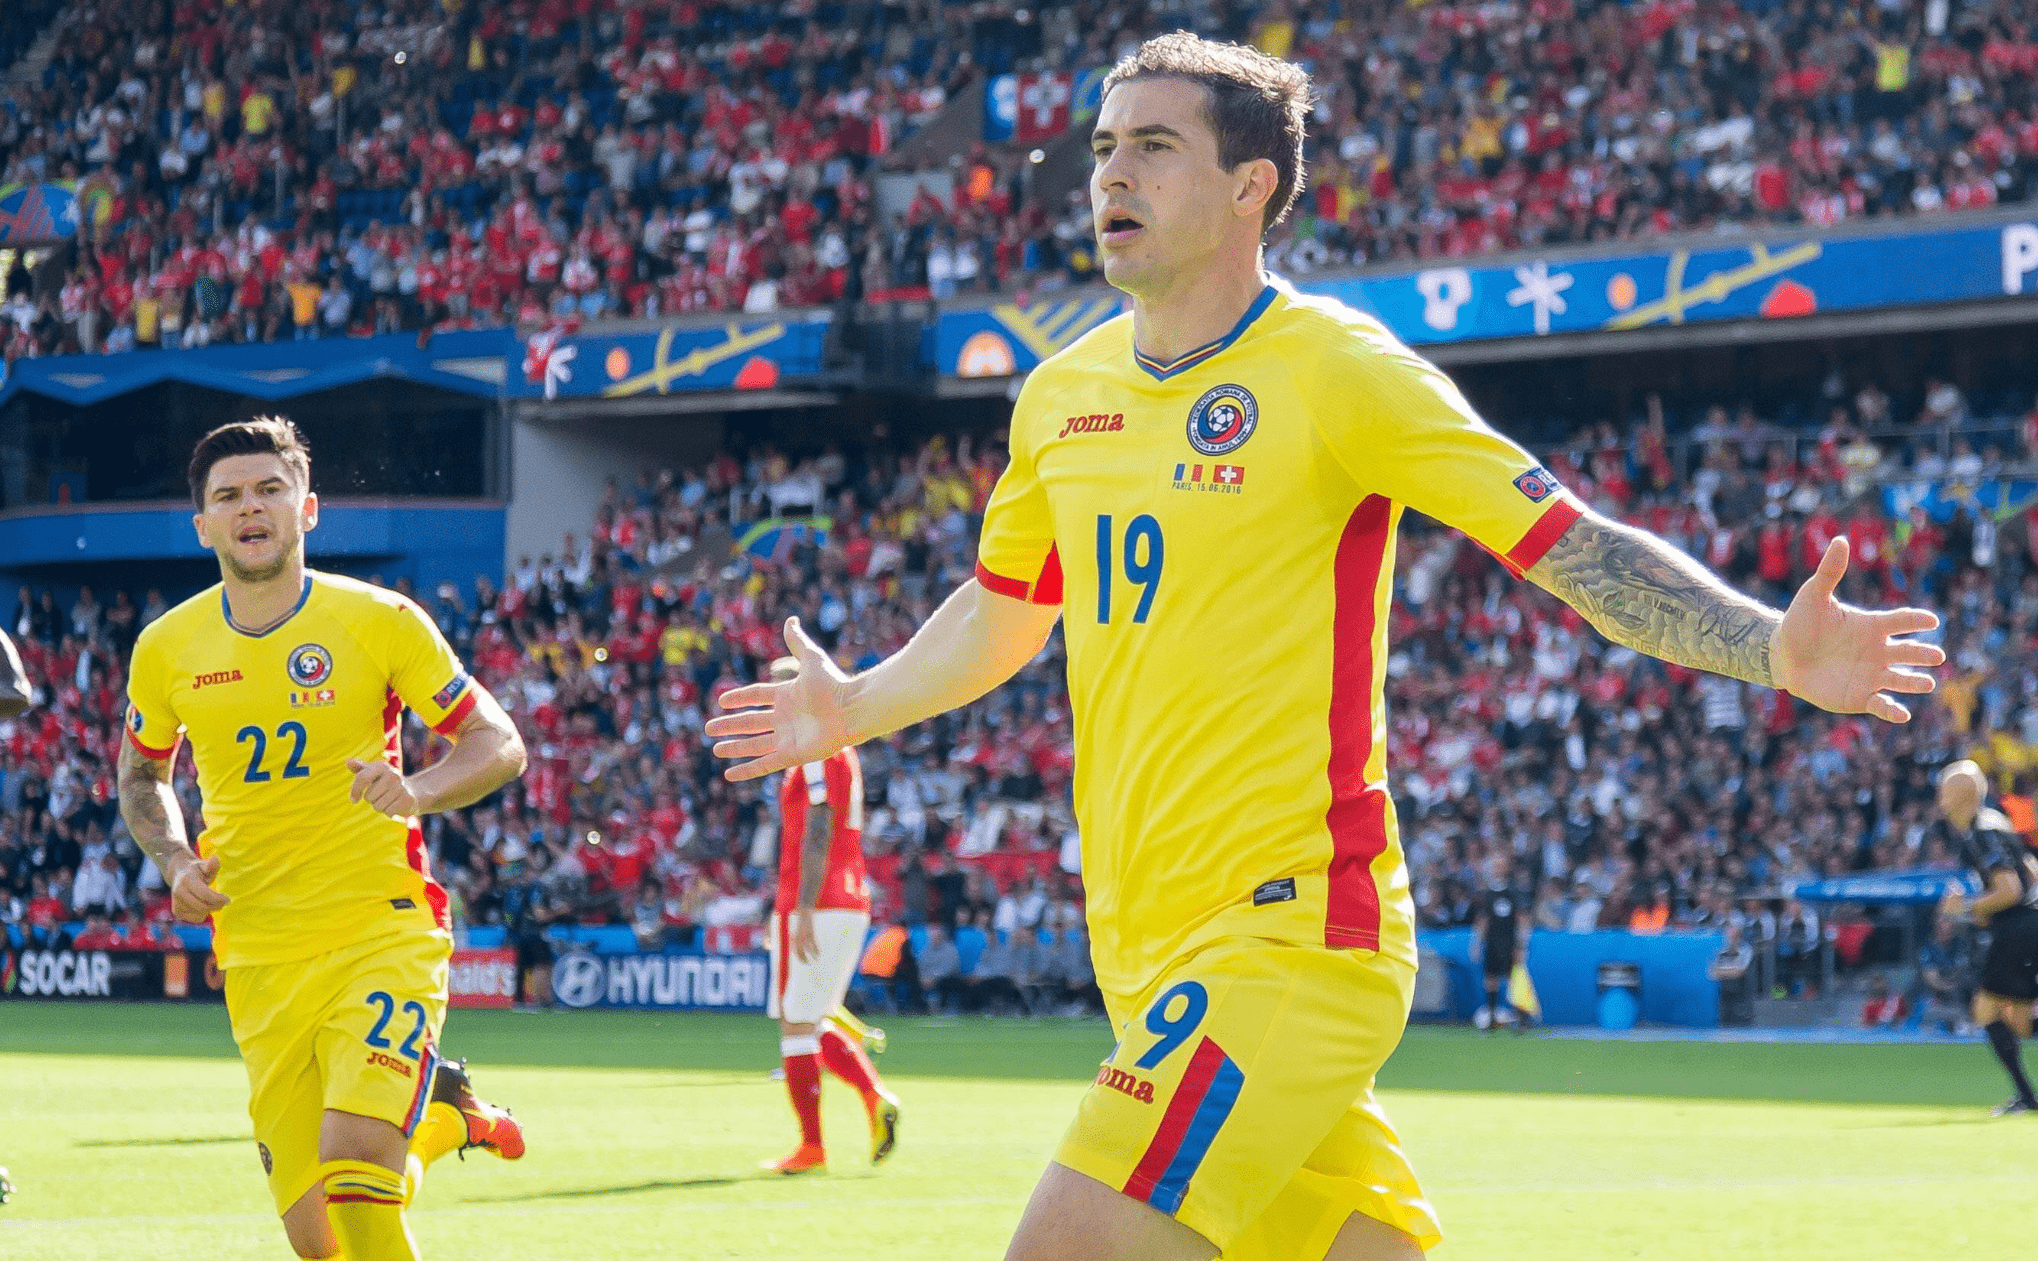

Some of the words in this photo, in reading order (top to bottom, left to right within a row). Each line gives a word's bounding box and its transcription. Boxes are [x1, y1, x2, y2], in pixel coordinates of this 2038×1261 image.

[1096, 514, 1164, 624] 19
[236, 721, 310, 783] 22
[19, 950, 111, 996] SOCAR
[608, 955, 767, 1007] HYUNDAI
[364, 991, 426, 1062] 22
[1096, 1065, 1154, 1105] oma
